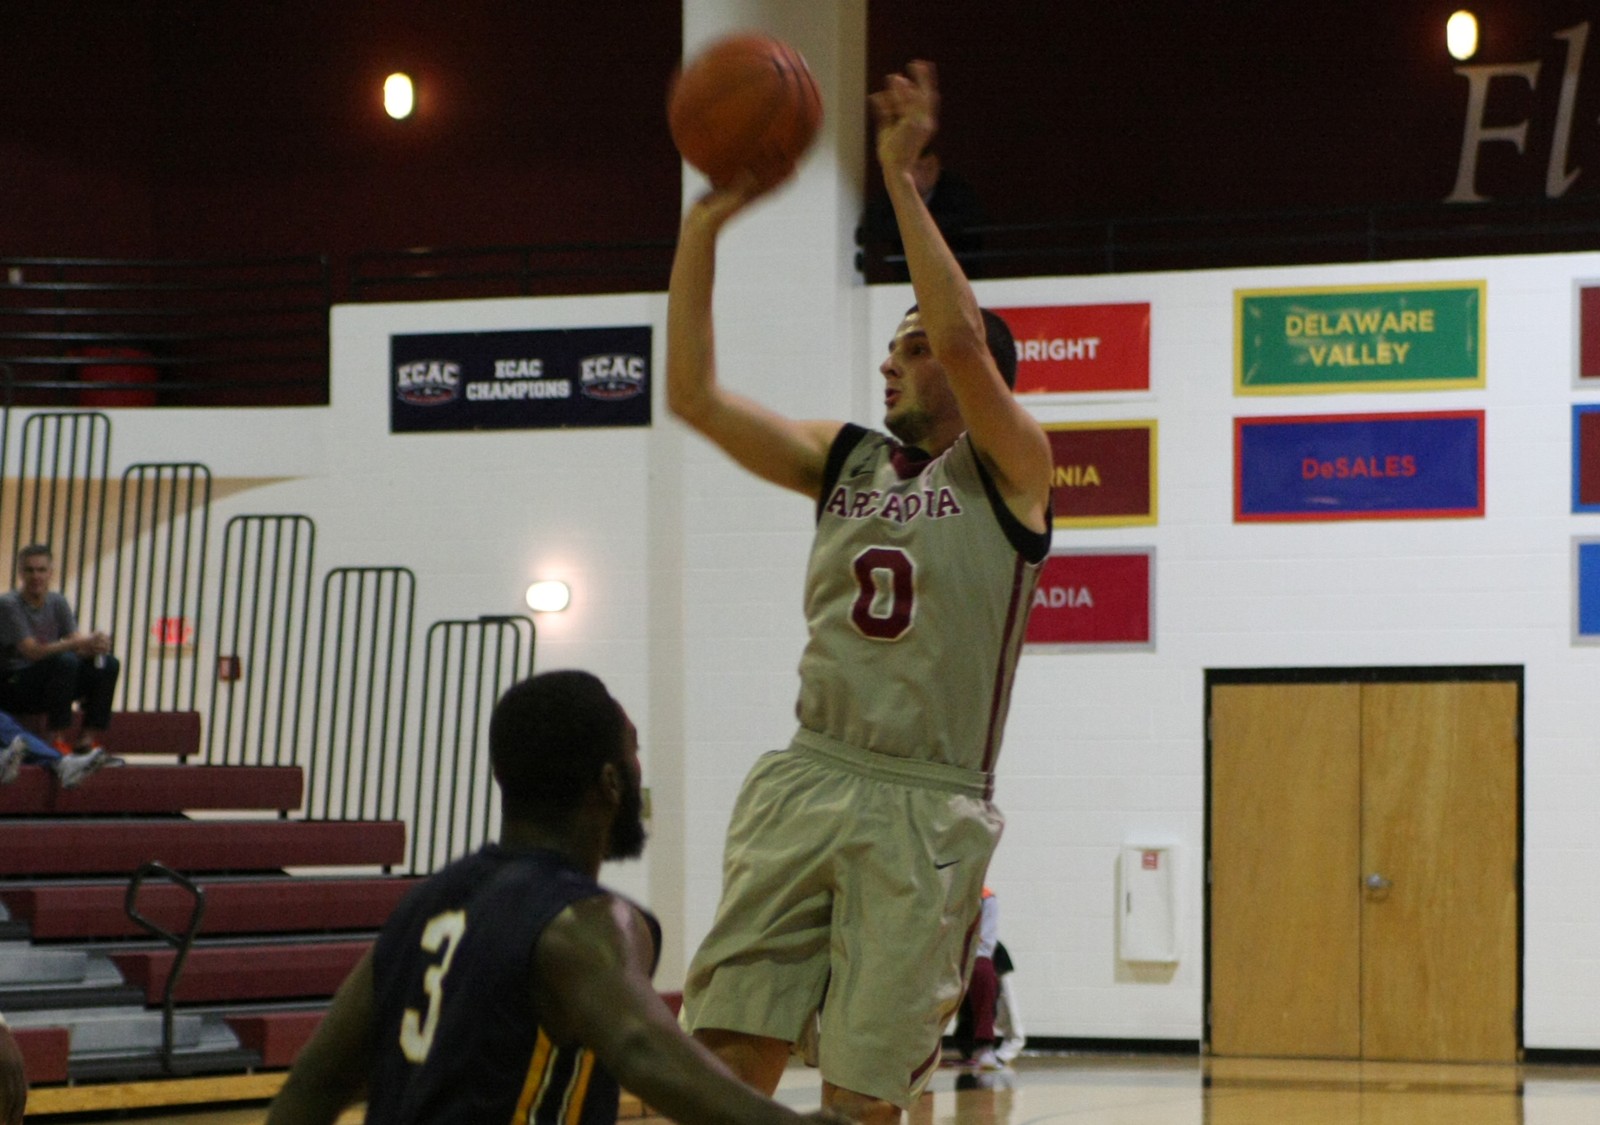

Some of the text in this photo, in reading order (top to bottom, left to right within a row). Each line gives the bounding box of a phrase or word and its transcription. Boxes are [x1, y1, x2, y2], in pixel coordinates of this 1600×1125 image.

[1443, 20, 1600, 204] Fl
[1285, 309, 1435, 337] DELAWARE
[1308, 341, 1411, 367] VALLEY
[397, 361, 460, 387] ECAC
[494, 360, 543, 378] ECAC
[581, 355, 645, 381] ECAC
[466, 379, 571, 401] CHAMPIONS
[1050, 465, 1101, 487] NIA
[1302, 454, 1417, 480] DeSALES
[826, 486, 963, 525] ARCADIA
[849, 545, 917, 642] 0
[400, 907, 467, 1066] 3
